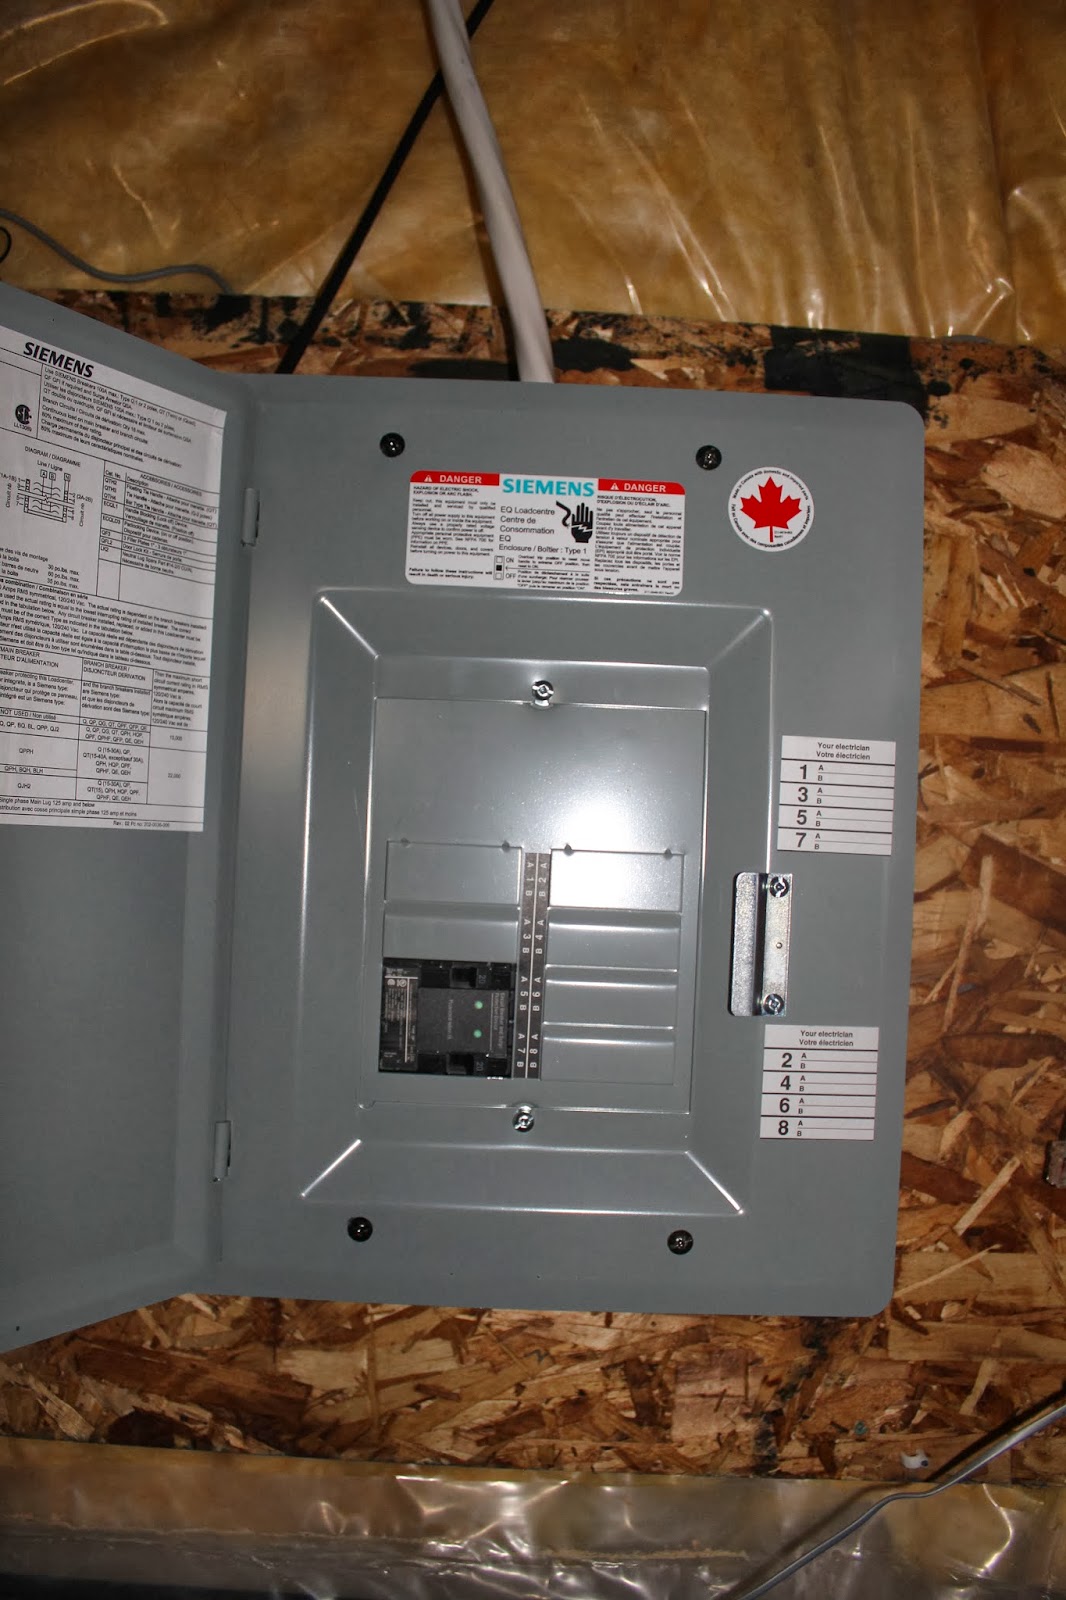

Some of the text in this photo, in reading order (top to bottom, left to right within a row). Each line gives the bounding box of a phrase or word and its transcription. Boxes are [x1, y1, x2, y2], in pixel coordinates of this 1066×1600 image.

[23, 341, 94, 378] SIEMENS
[24, 446, 80, 467] DIAGRAM DIAGRAMME
[50, 463, 62, 472] Ligne
[440, 475, 482, 484] DANGER
[502, 478, 595, 497] SIEMENS
[624, 483, 666, 492] DANGER
[515, 507, 555, 515] Loadcentre
[500, 526, 554, 534] Consommation
[538, 545, 559, 553] Boîtier
[565, 547, 581, 555] Type
[15, 648, 40, 657] BREAKER
[17, 656, 59, 668] D'ALIMENTATION
[84, 667, 146, 680] DISJONCTEUR DERIVATION
[835, 743, 870, 751] electrician
[836, 751, 870, 760] électricien
[800, 764, 807, 779] 1
[798, 787, 808, 802] 3
[796, 810, 807, 825] 5
[796, 832, 807, 847] 7
[782, 1053, 792, 1068] 2
[780, 1075, 791, 1090] 4
[780, 1098, 790, 1113] 6
[778, 1120, 788, 1135] 8
